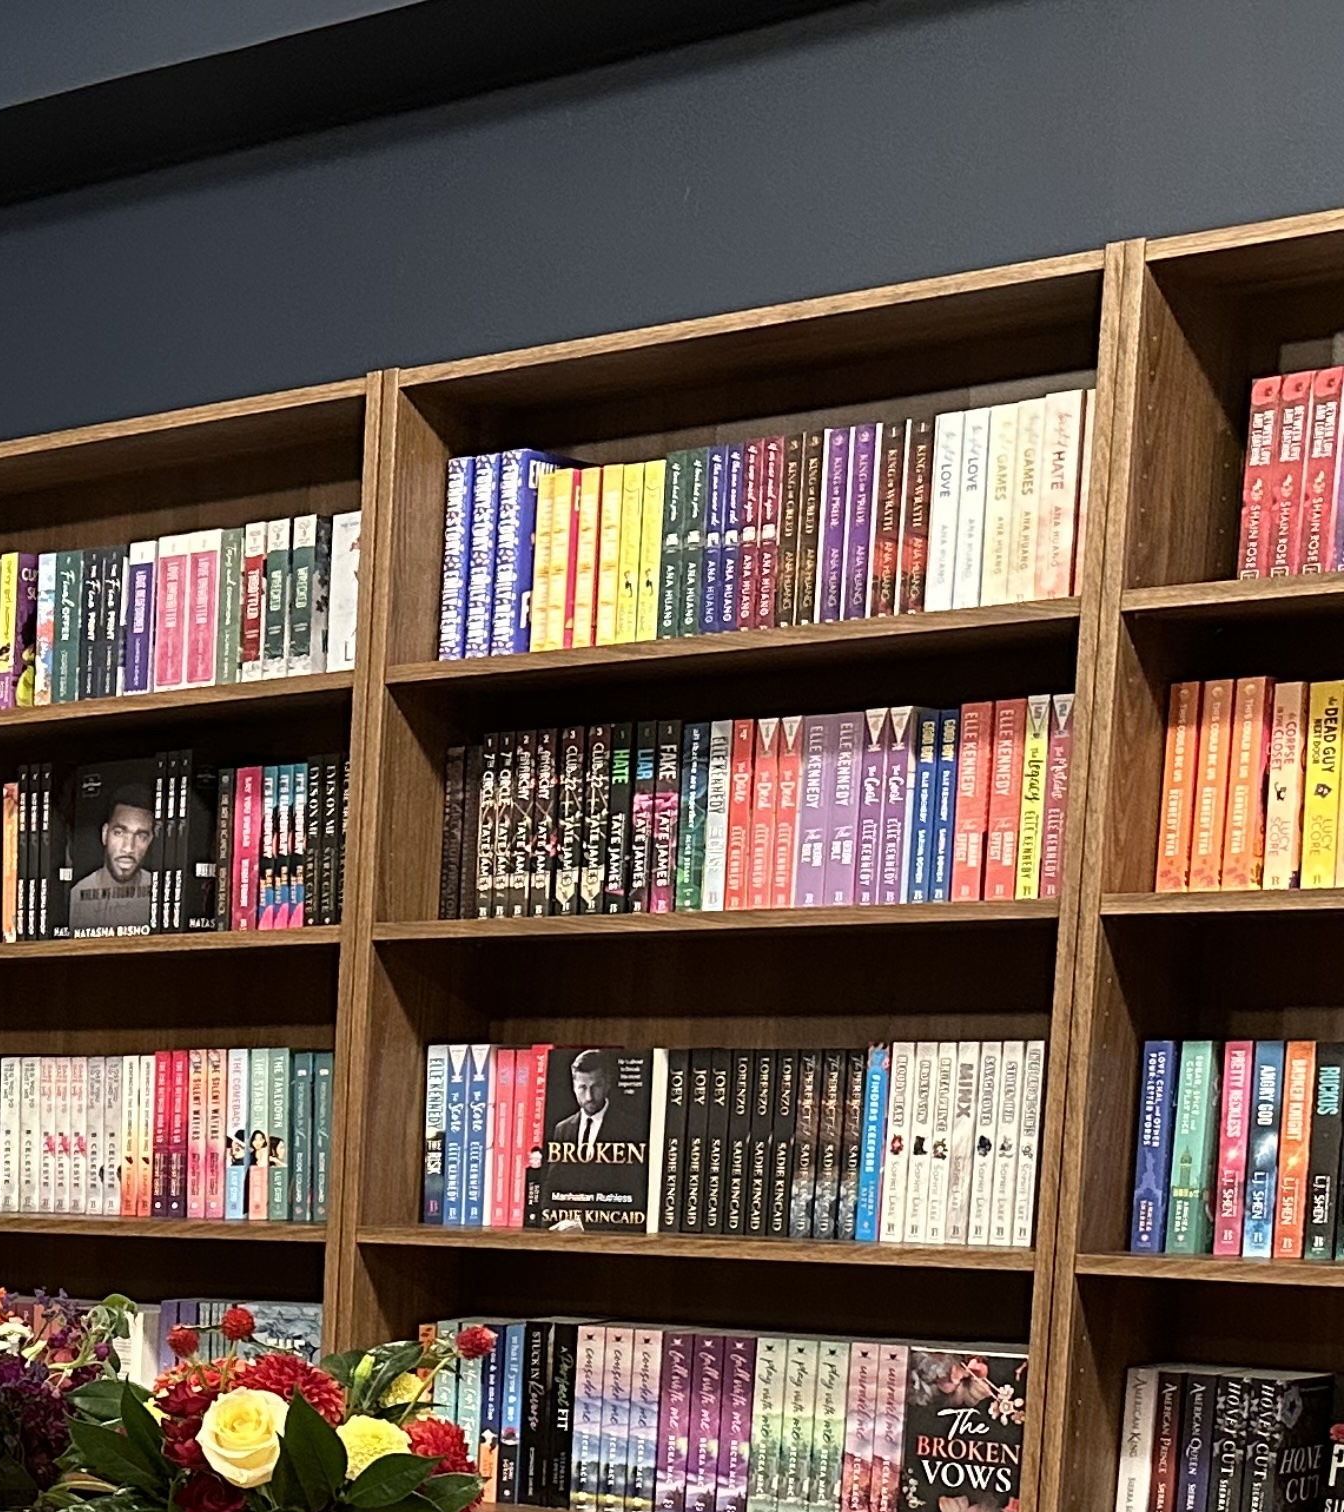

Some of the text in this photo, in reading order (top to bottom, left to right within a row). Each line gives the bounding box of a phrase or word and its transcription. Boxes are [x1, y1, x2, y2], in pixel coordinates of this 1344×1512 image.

[940, 463, 952, 498] LOVE
[966, 457, 979, 492] LOVE
[995, 455, 1008, 501] GAMES
[1022, 448, 1035, 495] GAMES
[1050, 450, 1065, 490] HATE
[763, 552, 771, 577] ANA
[663, 590, 674, 627] HUANG
[1272, 729, 1284, 771] CLOSET
[1284, 720, 1296, 765] CORPSE
[1322, 706, 1338, 774] DEAD GUY
[612, 749, 630, 785] HATE
[636, 749, 654, 780] LIAR
[657, 745, 677, 887] FAKE TATE JAMES
[74, 925, 150, 939] NATASHA BISHO
[713, 1067, 727, 1107] JOEY
[735, 1056, 749, 1116] LORENZO
[1230, 1049, 1246, 1087] PRETTY
[273, 1056, 284, 1129] THE TAKEDOWN
[427, 1058, 445, 1130] ELLE KENNEDY
[671, 1068, 684, 1107] JOEY
[956, 1063, 975, 1119] MINX
[1257, 1065, 1276, 1126] ANGRY GOD
[1317, 1066, 1341, 1116] RUCKUS
[547, 1141, 647, 1165] BROKEN
[542, 1209, 645, 1224] SADIE KINCAID
[552, 1192, 632, 1203] Manhattan Ruthless
[729, 1175, 742, 1230] KINCAID
[1312, 1193, 1325, 1224] SHEN
[557, 1408, 569, 1432] FIT
[937, 1408, 990, 1440] The
[916, 1435, 1021, 1466] BROKEN
[1220, 1440, 1236, 1477] CUT
[1254, 1442, 1270, 1480] CUT
[921, 1459, 1012, 1493] VOWS
